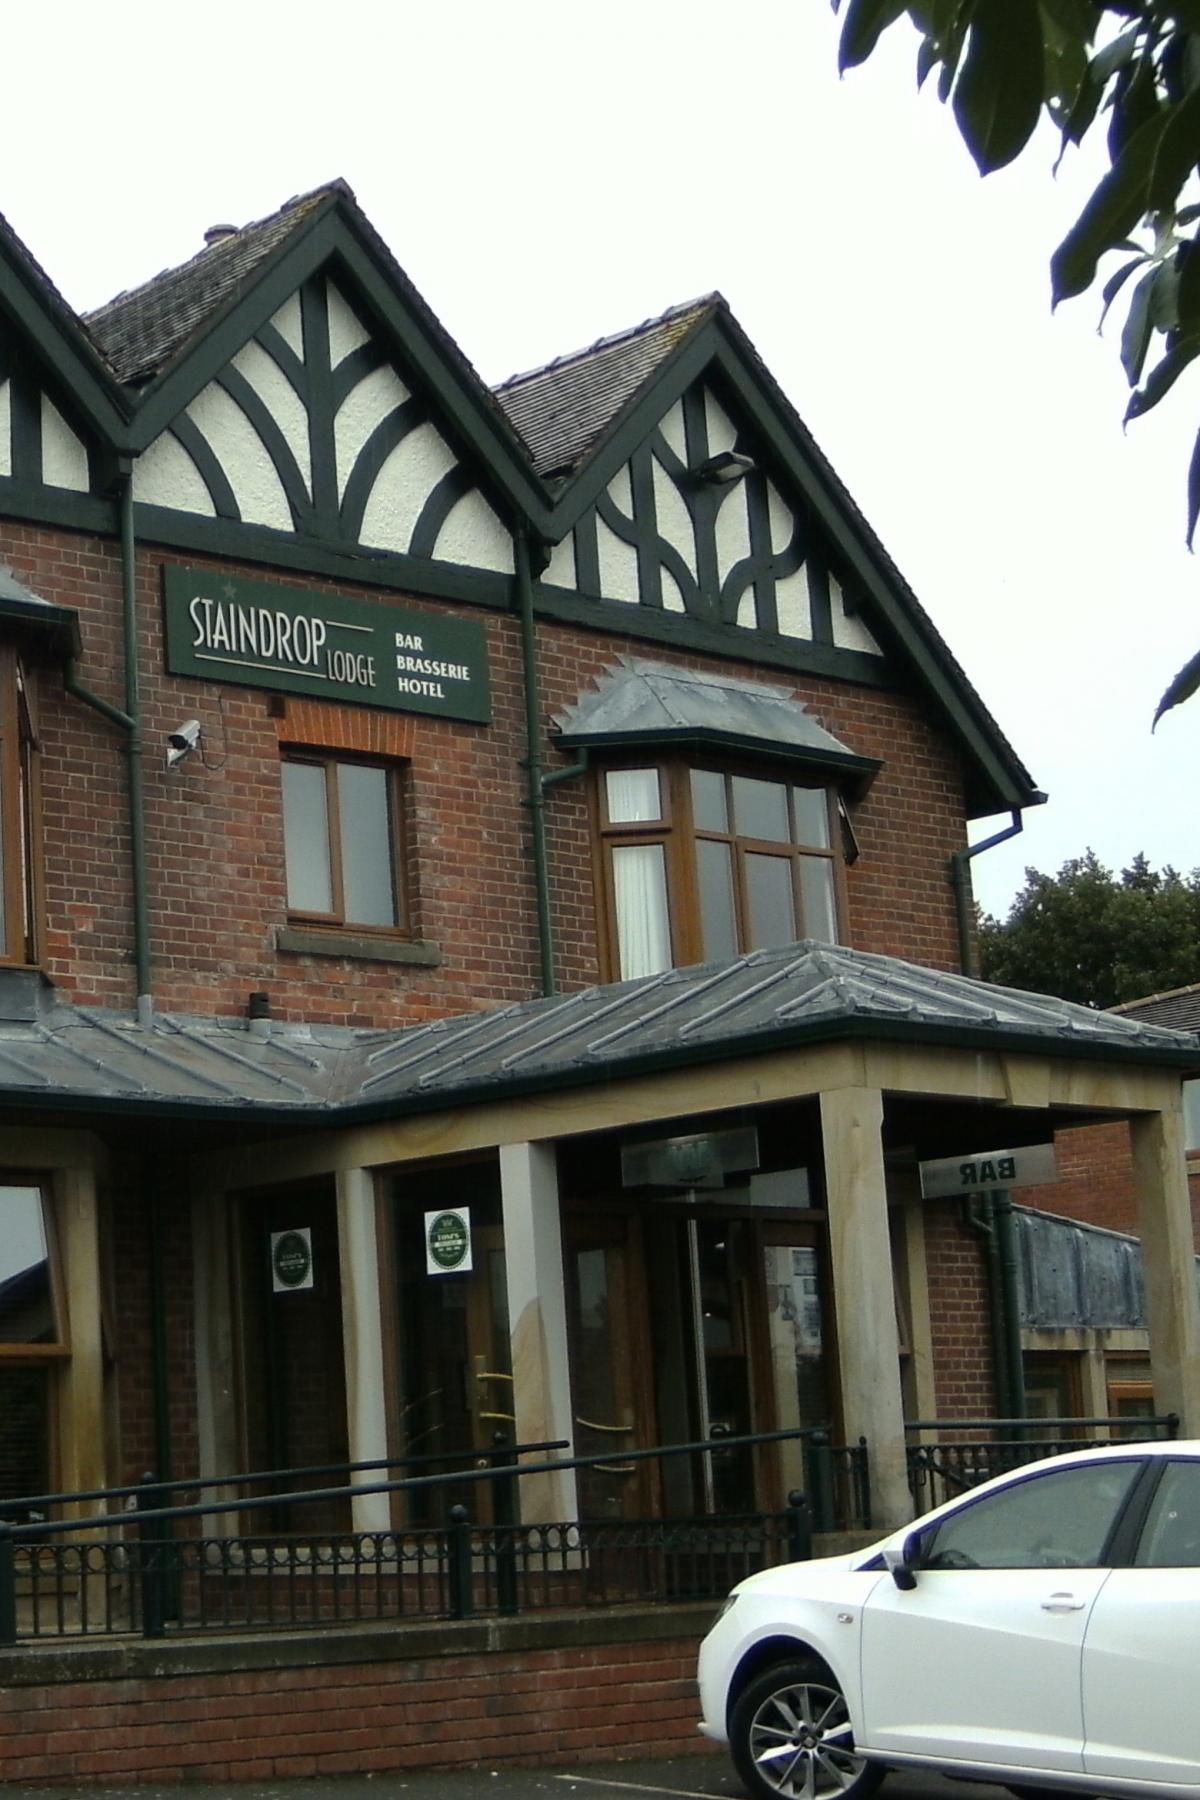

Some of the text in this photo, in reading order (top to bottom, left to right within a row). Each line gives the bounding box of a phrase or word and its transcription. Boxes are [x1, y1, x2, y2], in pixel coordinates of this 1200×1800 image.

[189, 597, 377, 688] STAINDROP LODGE
[395, 632, 424, 652] BAR
[396, 655, 471, 682] BRASSERIE
[398, 677, 446, 699] HOTEL
